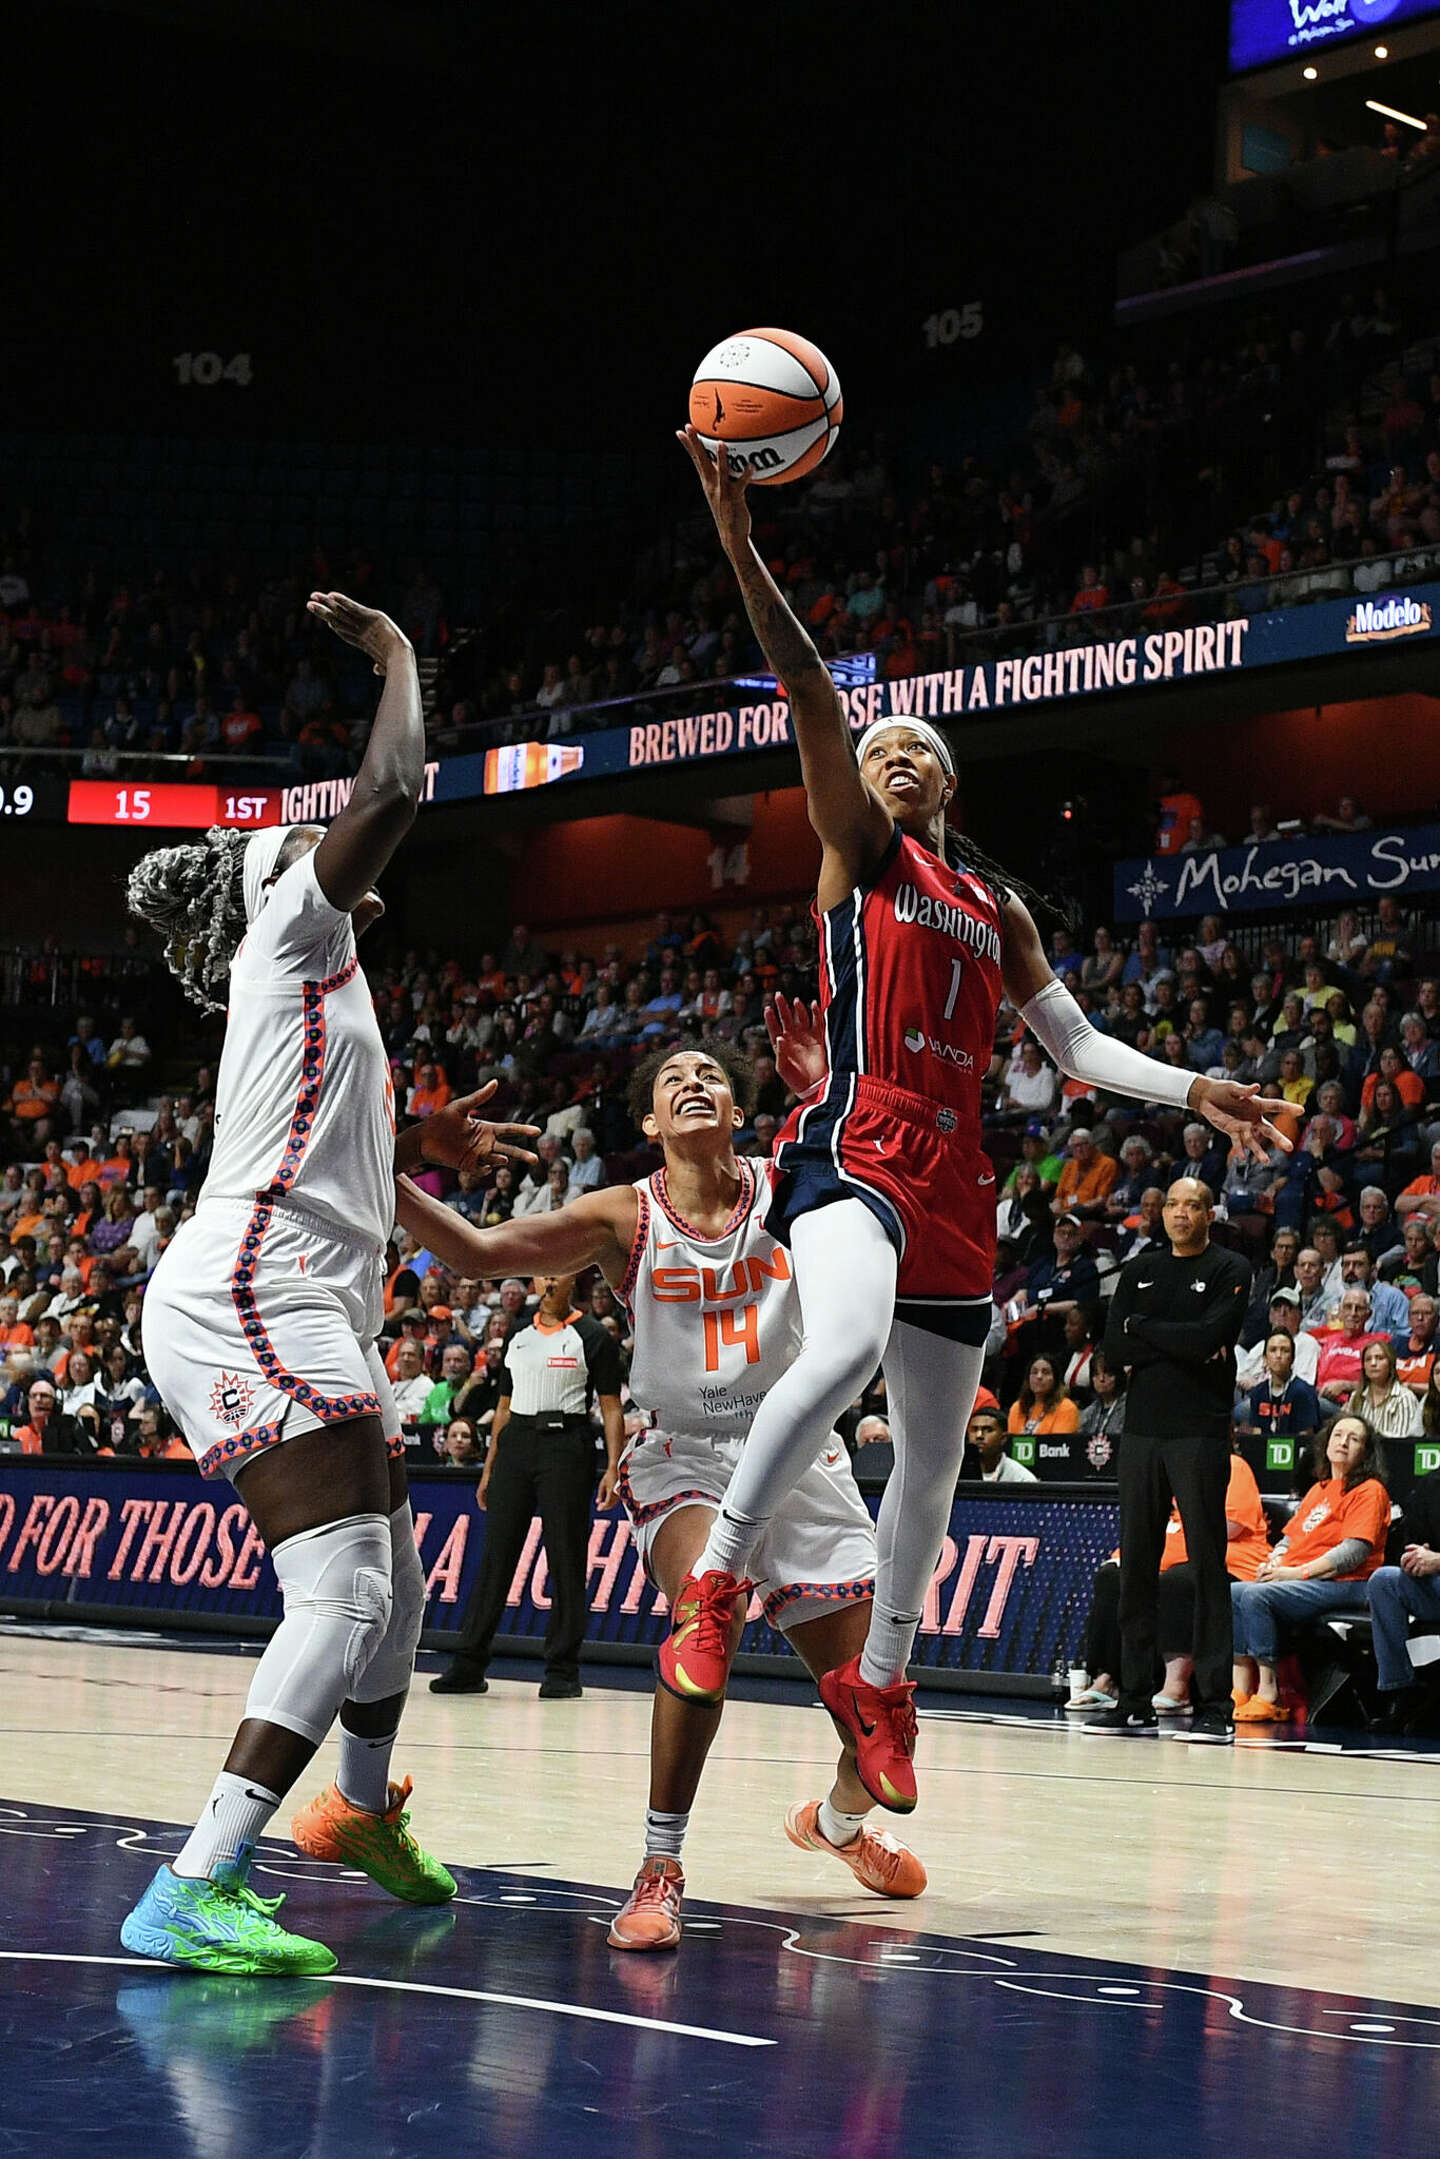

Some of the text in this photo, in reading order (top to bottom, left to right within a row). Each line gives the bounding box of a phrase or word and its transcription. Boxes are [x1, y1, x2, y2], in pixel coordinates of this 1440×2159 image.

[922, 303, 983, 347] 105
[173, 352, 253, 385] 104
[1356, 597, 1421, 633] Modelo
[629, 711, 733, 766] BREWED
[738, 701, 788, 748] FOR
[888, 668, 964, 717] WITH
[969, 665, 989, 709] A
[994, 638, 1138, 706] FIGHTING
[1143, 618, 1249, 681] SPIRIT
[114, 790, 151, 820] 15
[224, 797, 268, 819] 1ST
[1174, 846, 1358, 910] Mohegan
[943, 958, 963, 1020] 1
[652, 1247, 791, 1302] SUN
[703, 1305, 760, 1372] 14
[699, 1385, 727, 1399] Yale
[702, 1391, 767, 1415] NewHave
[1015, 1443, 1070, 1461] TD Bank
[1270, 1444, 1292, 1464] TD
[6, 1495, 110, 1579] FOR
[107, 1498, 267, 1590] THOSE
